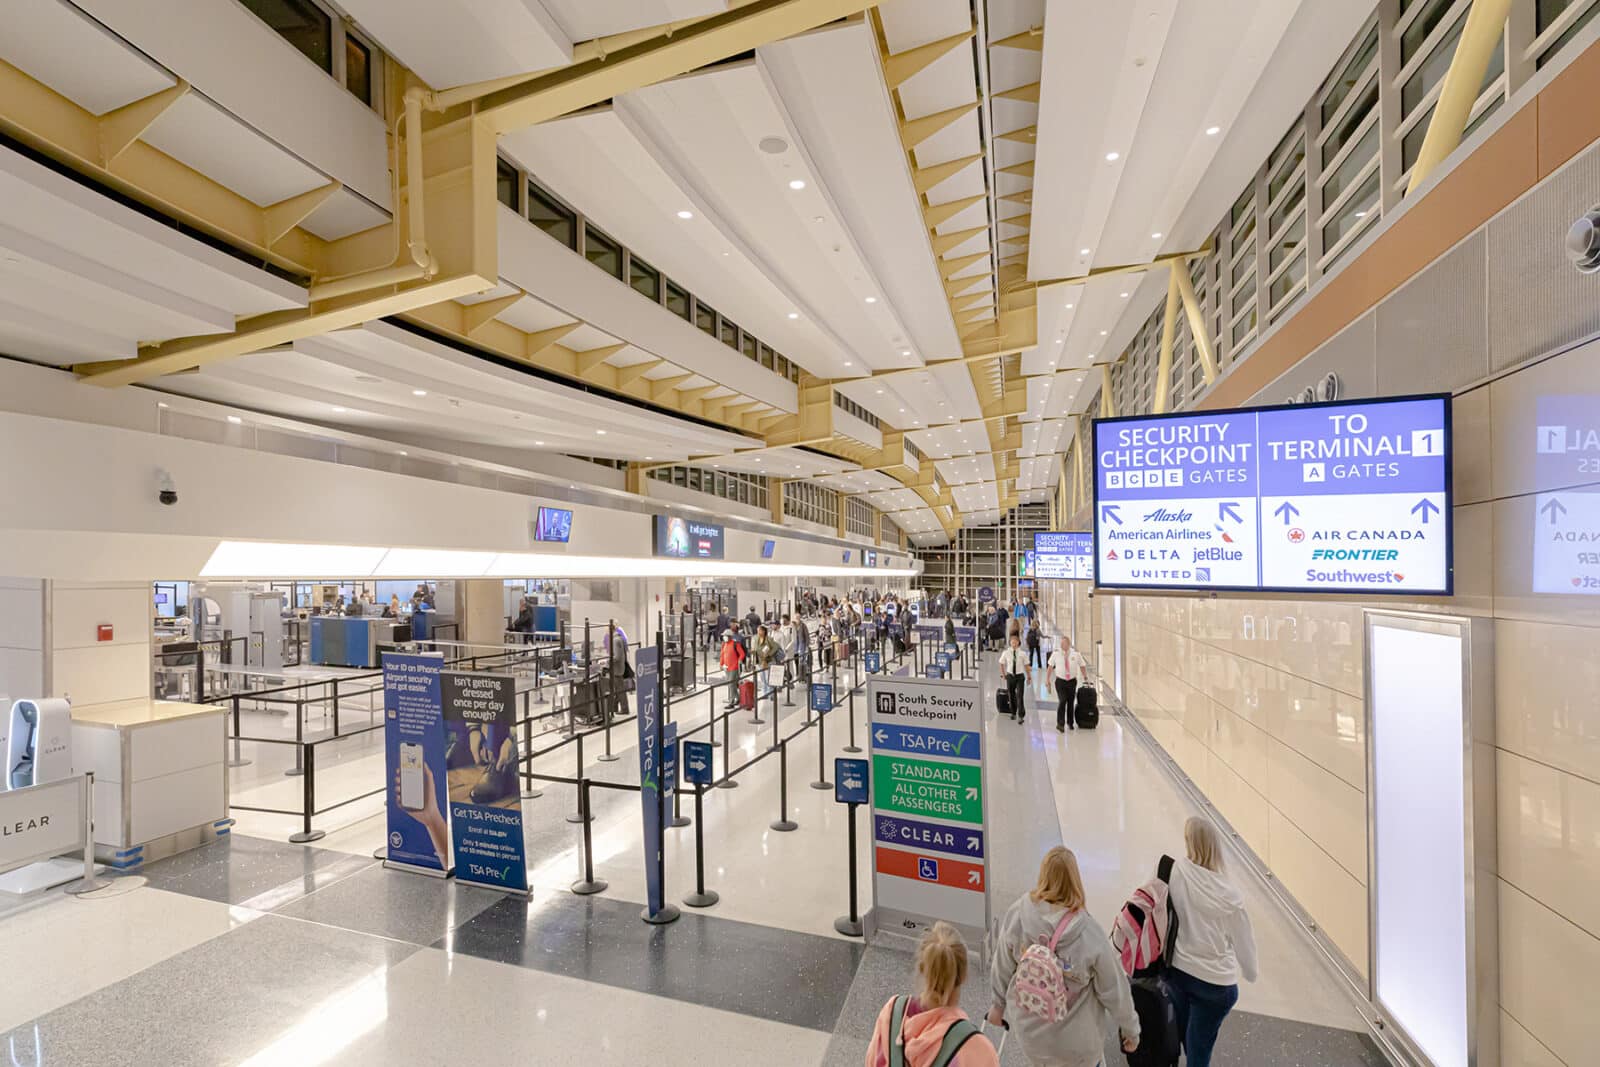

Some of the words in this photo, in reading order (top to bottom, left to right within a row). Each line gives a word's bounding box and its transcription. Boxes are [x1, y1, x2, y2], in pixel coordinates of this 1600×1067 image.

[1329, 414, 1368, 435] TO
[1119, 423, 1230, 447] SECURITY
[1101, 443, 1252, 468] CHECKPOINT
[1268, 436, 1411, 461] TERMINAL
[1189, 469, 1247, 484] GATES
[1333, 462, 1400, 478] GATES
[1143, 508, 1193, 523] Alaska
[1108, 529, 1165, 540] American
[1166, 528, 1212, 540] Airlines
[1312, 530, 1342, 541] AIR
[1347, 529, 1425, 541] CANADA
[1124, 550, 1180, 560] DELTA
[1193, 547, 1243, 563] jetBlue
[1312, 549, 1399, 561] FRONTIER
[1131, 569, 1191, 579] UNITED
[1306, 568, 1392, 584] Southwest
[385, 662, 399, 671] Your
[400, 663, 408, 672] ID
[386, 672, 407, 683] Airport
[408, 675, 433, 686] security
[454, 676, 471, 687] Isn't
[472, 678, 501, 691] getting
[462, 687, 494, 699] dressed
[453, 699, 472, 708] once
[473, 700, 487, 710] per
[488, 700, 505, 712] day
[898, 693, 927, 705] South
[930, 695, 973, 711] Security
[462, 710, 497, 721] enough?
[644, 688, 655, 732] TSA
[899, 706, 957, 721] Checkpoint
[899, 732, 926, 750] TSA
[927, 735, 950, 752] Pre
[644, 735, 655, 771] Pre
[891, 763, 961, 783] STANDARD
[895, 783, 915, 796] ALL
[918, 786, 958, 801] OTHER
[891, 795, 963, 816] PASSENGERS
[454, 807, 467, 818] Get
[468, 809, 483, 820] TSA
[3, 816, 50, 836] LEAR
[901, 826, 955, 847] CLEAR
[469, 864, 484, 876] TSA
[485, 867, 500, 879] Pre
